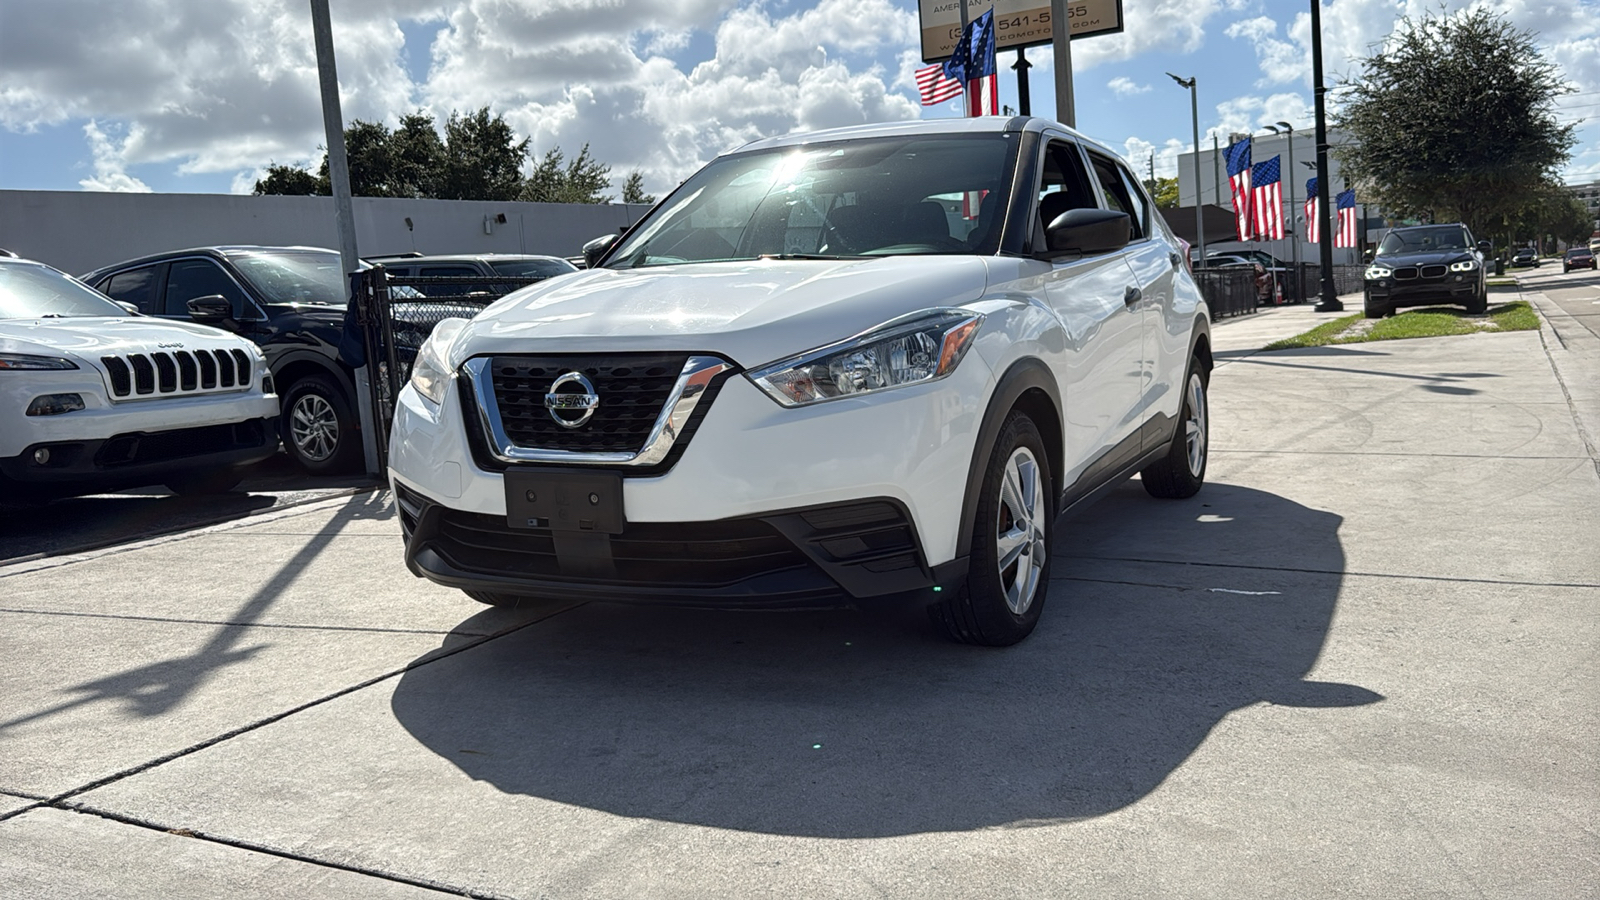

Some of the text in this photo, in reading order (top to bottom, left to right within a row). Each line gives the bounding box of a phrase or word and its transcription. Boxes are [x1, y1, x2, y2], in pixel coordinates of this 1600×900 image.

[933, 0, 982, 13] AMERAN
[999, 6, 1088, 30] 541-555
[547, 397, 591, 406] NISSAN
